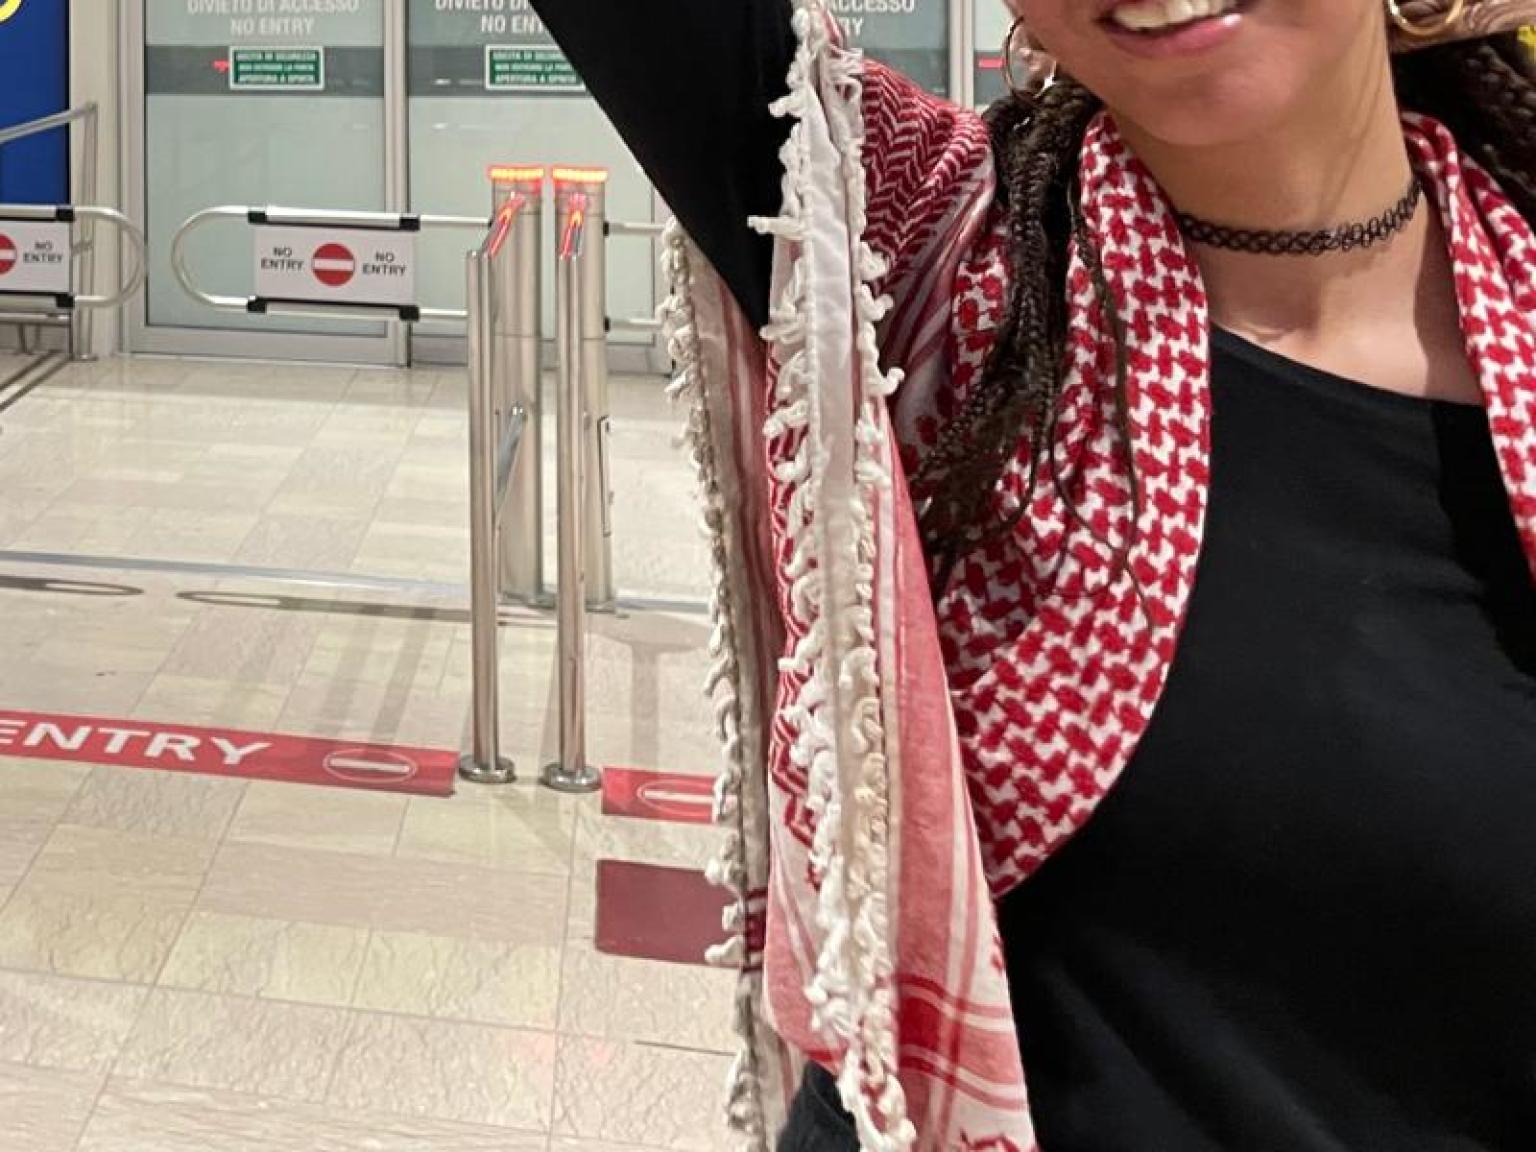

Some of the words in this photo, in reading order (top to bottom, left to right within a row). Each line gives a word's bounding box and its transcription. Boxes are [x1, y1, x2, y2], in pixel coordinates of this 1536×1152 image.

[230, 17, 254, 36] NO
[260, 17, 314, 36] ENTRY
[481, 14, 506, 33] NO
[512, 14, 546, 33] ENT
[23, 253, 63, 263] ENTRY
[273, 246, 293, 258] NO
[375, 251, 395, 263] NO
[261, 258, 304, 271] ENTRY
[363, 263, 407, 277] ENTRY
